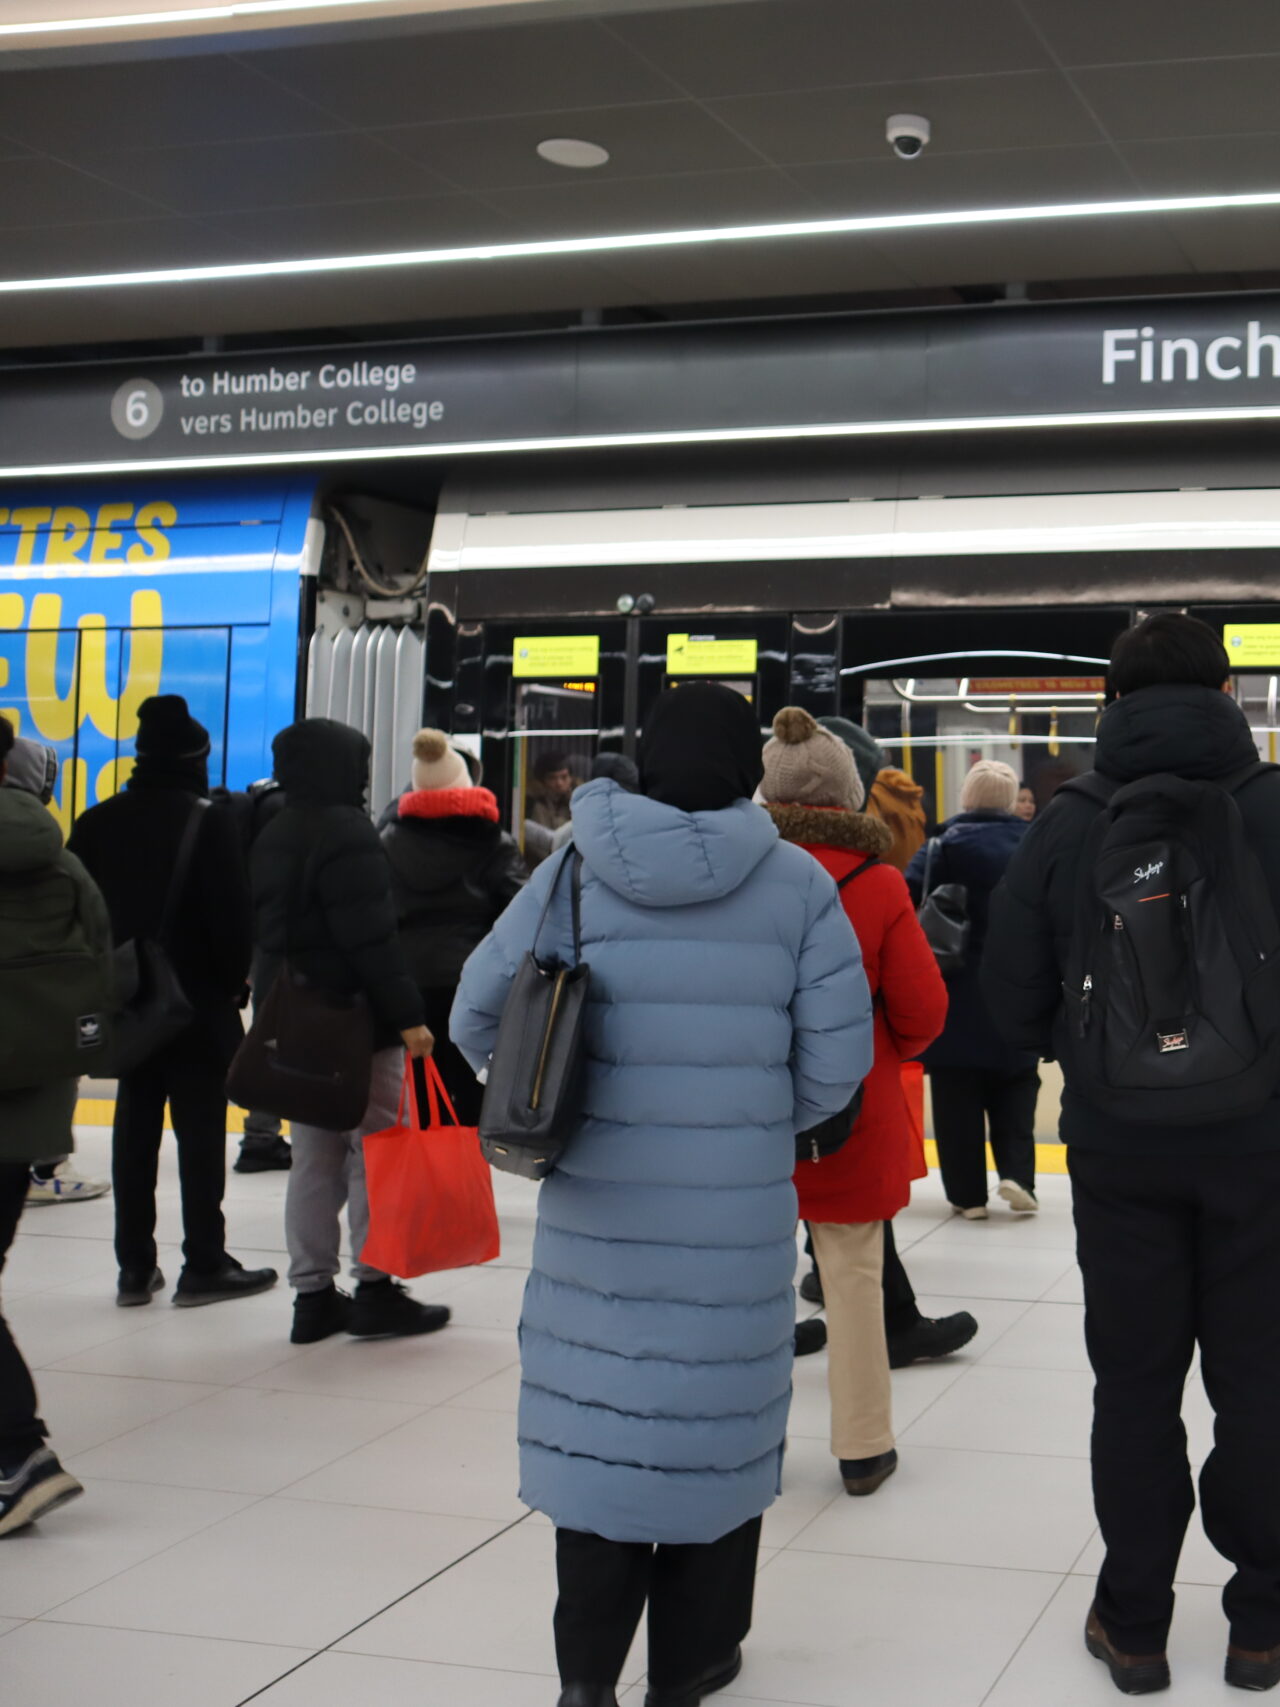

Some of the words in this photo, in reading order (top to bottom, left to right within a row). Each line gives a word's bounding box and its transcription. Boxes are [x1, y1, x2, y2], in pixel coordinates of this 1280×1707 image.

[180, 374, 205, 398] to
[213, 367, 311, 396] Humber
[318, 360, 417, 391] College
[124, 390, 150, 428] 6
[180, 411, 233, 435] vers
[240, 404, 338, 431] Humber
[346, 398, 444, 428] College
[0, 501, 178, 579] TRES
